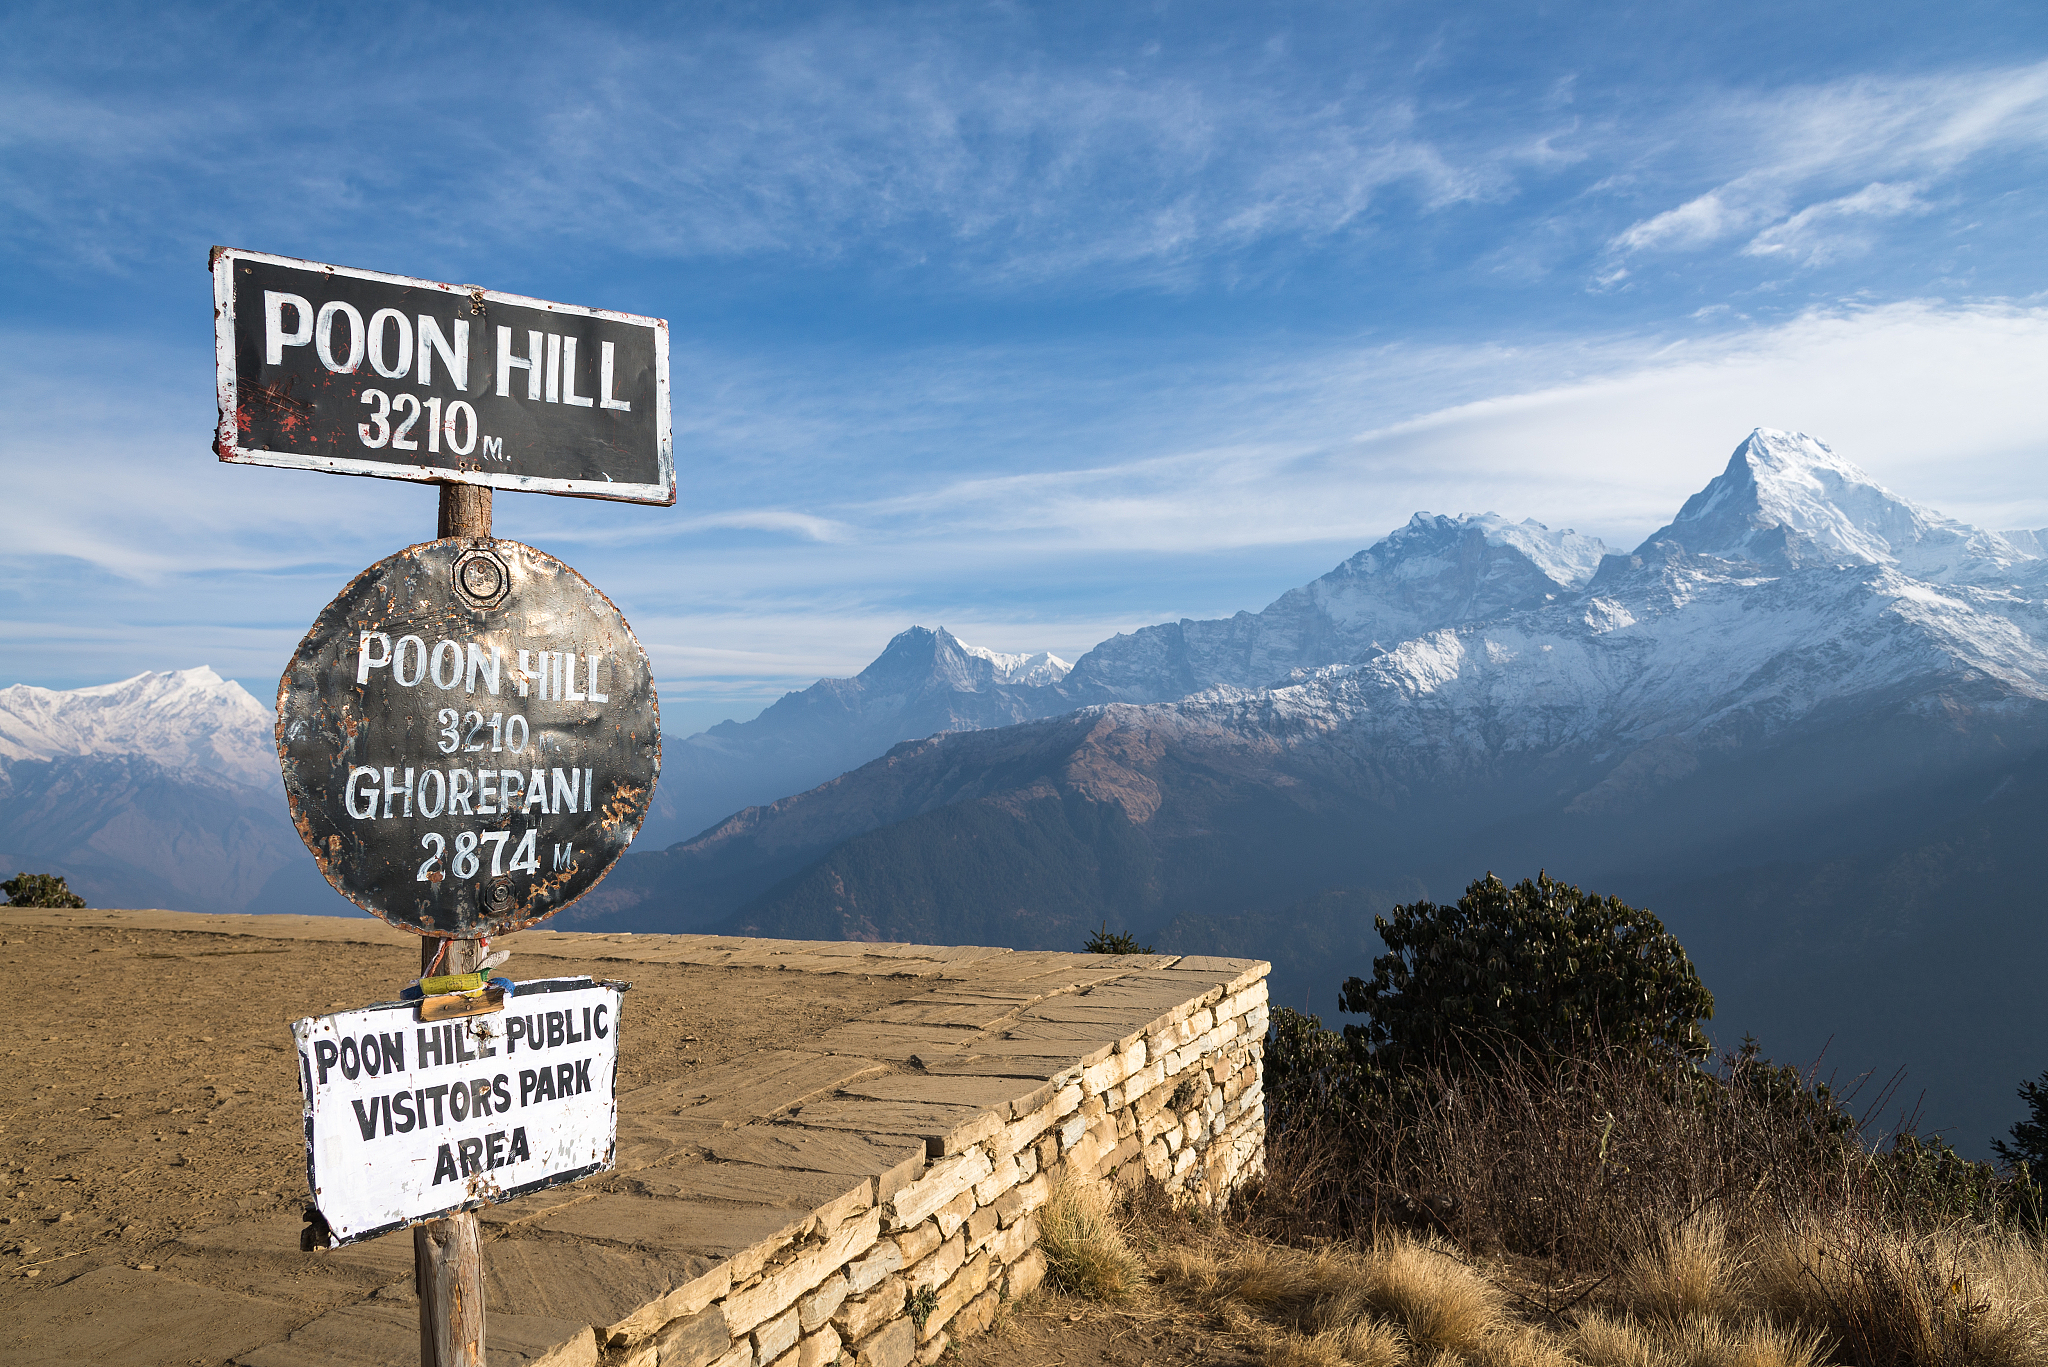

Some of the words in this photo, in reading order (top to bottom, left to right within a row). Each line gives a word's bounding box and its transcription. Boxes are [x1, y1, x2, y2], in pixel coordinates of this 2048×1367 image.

[264, 289, 470, 391] POON
[496, 325, 631, 412] HILL
[357, 388, 478, 456] 3210
[483, 435, 511, 462] M.
[356, 630, 500, 695] POON
[518, 648, 609, 703] HILL
[437, 707, 530, 755] 3210
[345, 766, 593, 820] GHOREPANI
[416, 828, 540, 882] 2874
[314, 1031, 405, 1085] POON
[506, 1003, 609, 1054] PUBLIC
[351, 1073, 511, 1142] VISITORS
[519, 1058, 592, 1107] PARK
[432, 1126, 530, 1187] AREA
